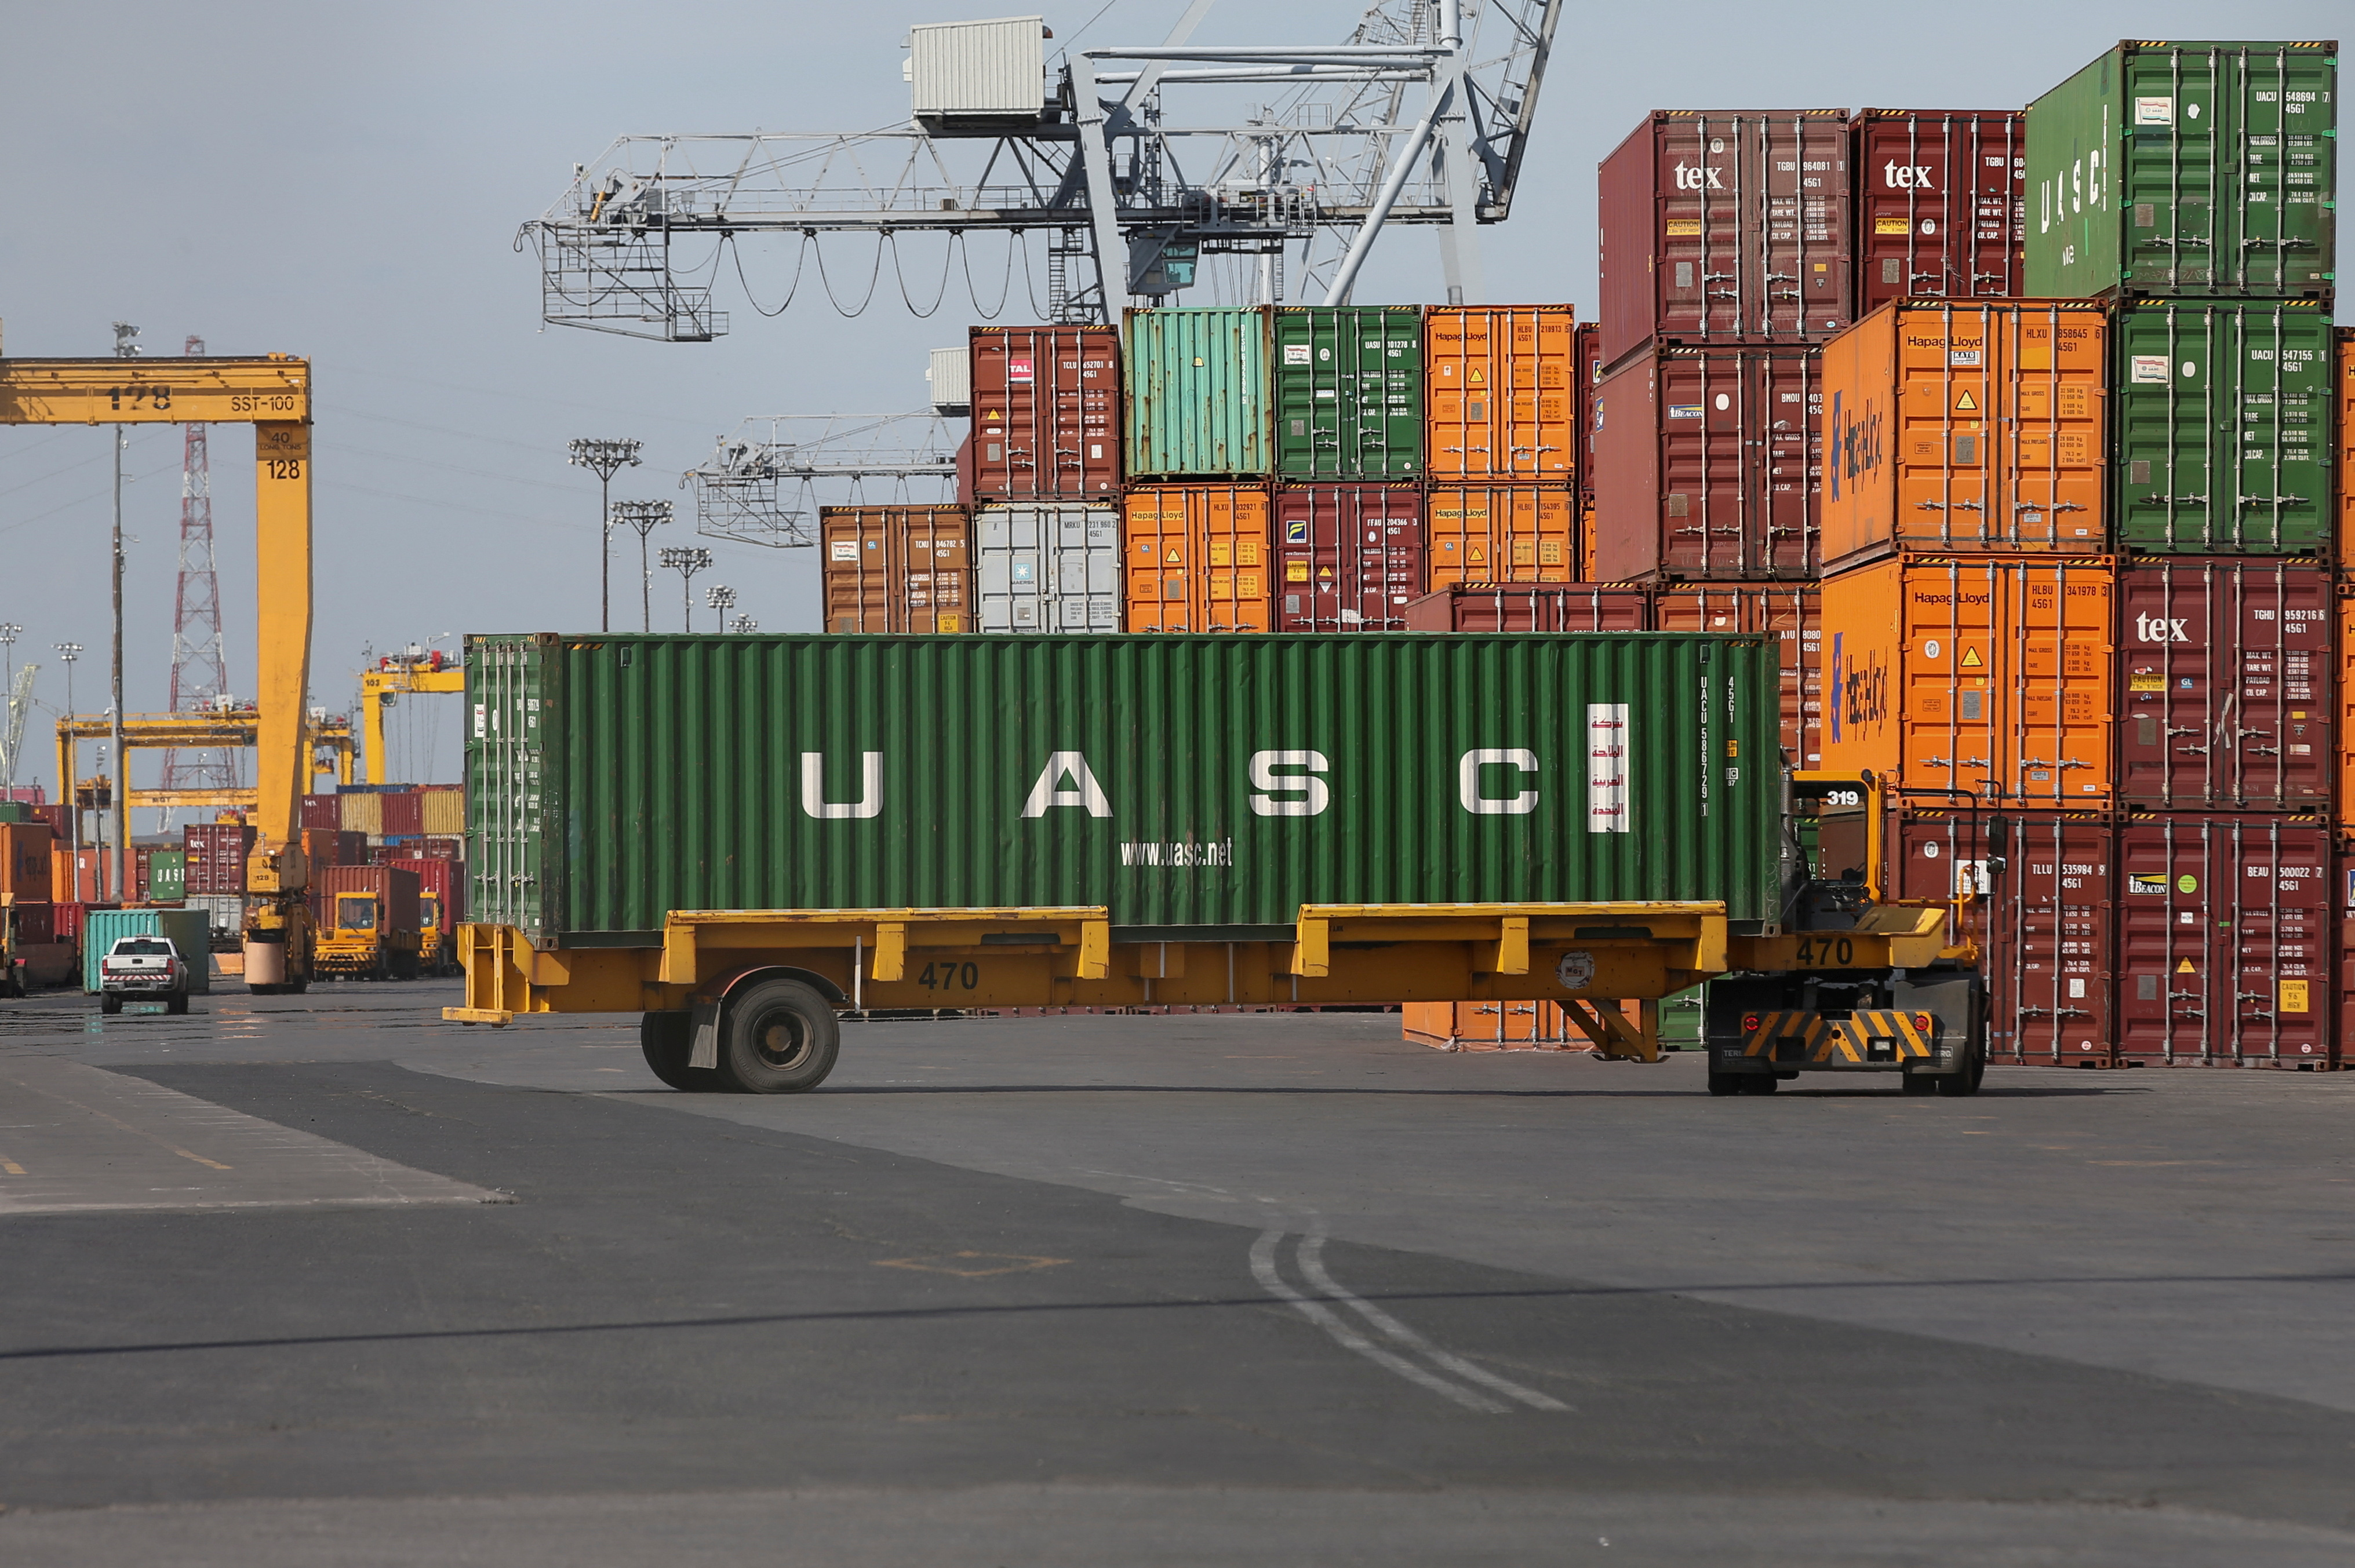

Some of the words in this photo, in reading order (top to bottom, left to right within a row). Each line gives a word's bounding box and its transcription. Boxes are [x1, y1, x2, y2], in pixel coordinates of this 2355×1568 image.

[2256, 92, 2277, 101] UACU
[2285, 92, 2316, 101] 548694
[2324, 92, 2329, 102] 7
[2285, 104, 2305, 114] 45G1
[1777, 161, 1795, 171] TGBU
[1803, 162, 1830, 171] 964081
[1839, 162, 1843, 170] 1
[1985, 157, 2004, 166] TGBU
[1675, 161, 1726, 190] tex
[1884, 159, 1935, 189] tex
[1803, 178, 1821, 187] 45G1
[2026, 329, 2047, 338] HLXU
[2058, 329, 2087, 338] 858645
[2095, 329, 2100, 338] 6
[1908, 336, 1982, 349] Hapag-Lloyd
[2058, 342, 2077, 352] 45G1
[2251, 351, 2273, 360] UACU
[2283, 350, 2313, 360] 547155
[2320, 351, 2325, 360] 1
[1083, 360, 1104, 369] 652701
[2283, 362, 2302, 371] 45G1
[105, 386, 170, 411] 128
[1782, 393, 1800, 403] BMOU
[231, 396, 294, 411] SST-100
[1675, 409, 1704, 417] BEACON
[2244, 413, 2258, 422] TARE
[272, 432, 290, 444] 40
[2245, 432, 2255, 441] NET
[266, 460, 300, 480] 128
[2033, 585, 2052, 595] HLBU
[2067, 586, 2096, 596] 341978
[2102, 587, 2107, 596] 3
[1915, 592, 1989, 605] Hapag-Lloyd
[2032, 599, 2052, 608] 45G1
[2254, 610, 2274, 620] TGHU
[2285, 610, 2317, 620] 959216
[2319, 610, 2324, 619] 6
[2136, 611, 2192, 643] tex
[2285, 624, 2306, 633] 45G1
[1803, 643, 1820, 651] 45G1
[1592, 717, 1623, 730] شركة
[1592, 745, 1623, 757] الملاحة
[1592, 774, 1623, 787] العربية
[1828, 792, 1858, 805] 319
[1592, 803, 1623, 815] المتحدة
[1702, 804, 1706, 815] 1
[190, 840, 205, 848] tex
[1121, 837, 1233, 866] www.uasc.net
[2032, 865, 2052, 874] TLLU
[2062, 865, 2092, 875] 535984
[2099, 865, 2105, 875] 9
[2248, 867, 2269, 877] BEAU
[2279, 867, 2310, 877] 500022
[2062, 878, 2081, 888] 45G1
[2279, 881, 2298, 891] 45G1
[2135, 884, 2166, 893] BEACON
[1797, 938, 1853, 965] 470
[919, 962, 978, 990] 470
